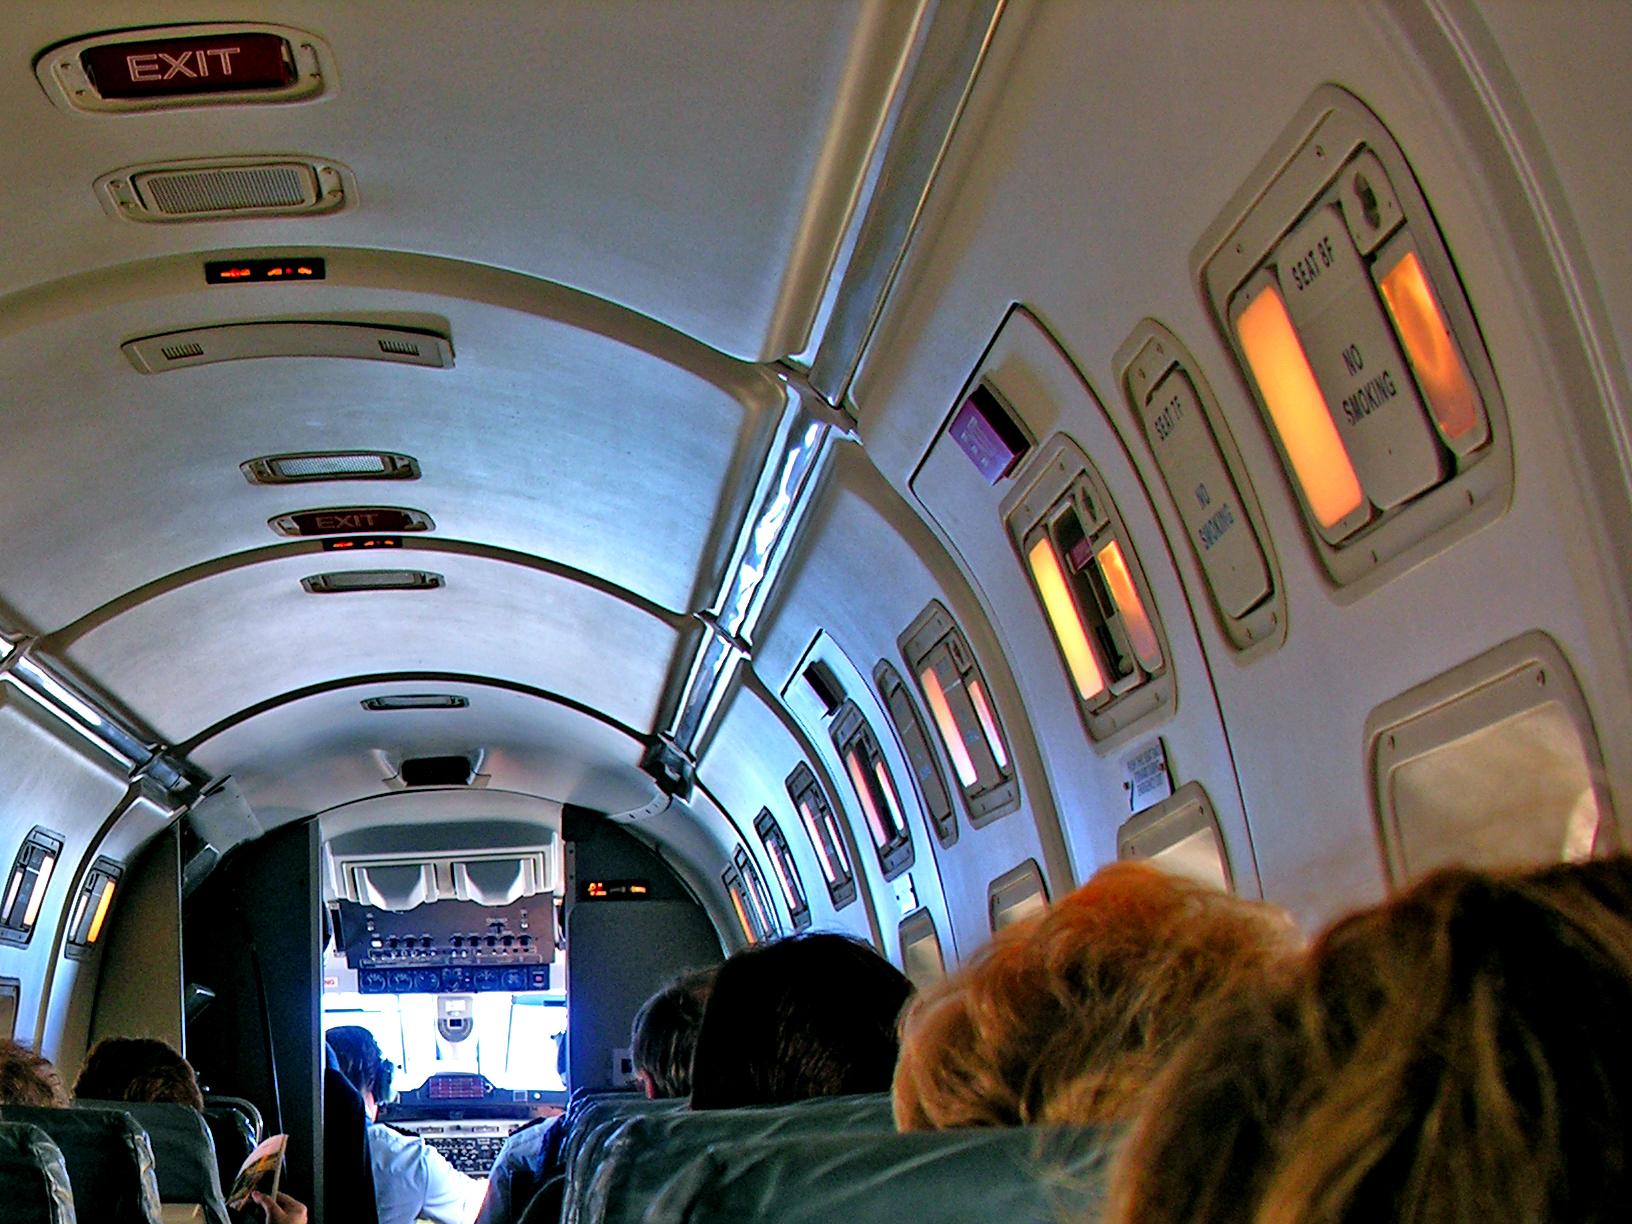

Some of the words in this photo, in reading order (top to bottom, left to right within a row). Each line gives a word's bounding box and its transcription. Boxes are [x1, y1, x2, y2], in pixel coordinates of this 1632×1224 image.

[126, 47, 241, 82] EXIT
[1291, 250, 1320, 291] SEAT
[1317, 236, 1335, 269] 8F
[1341, 343, 1364, 377] NO
[1341, 369, 1397, 427] SMOKING
[314, 513, 379, 529] EXIT
[1198, 503, 1235, 551] SMOKING
